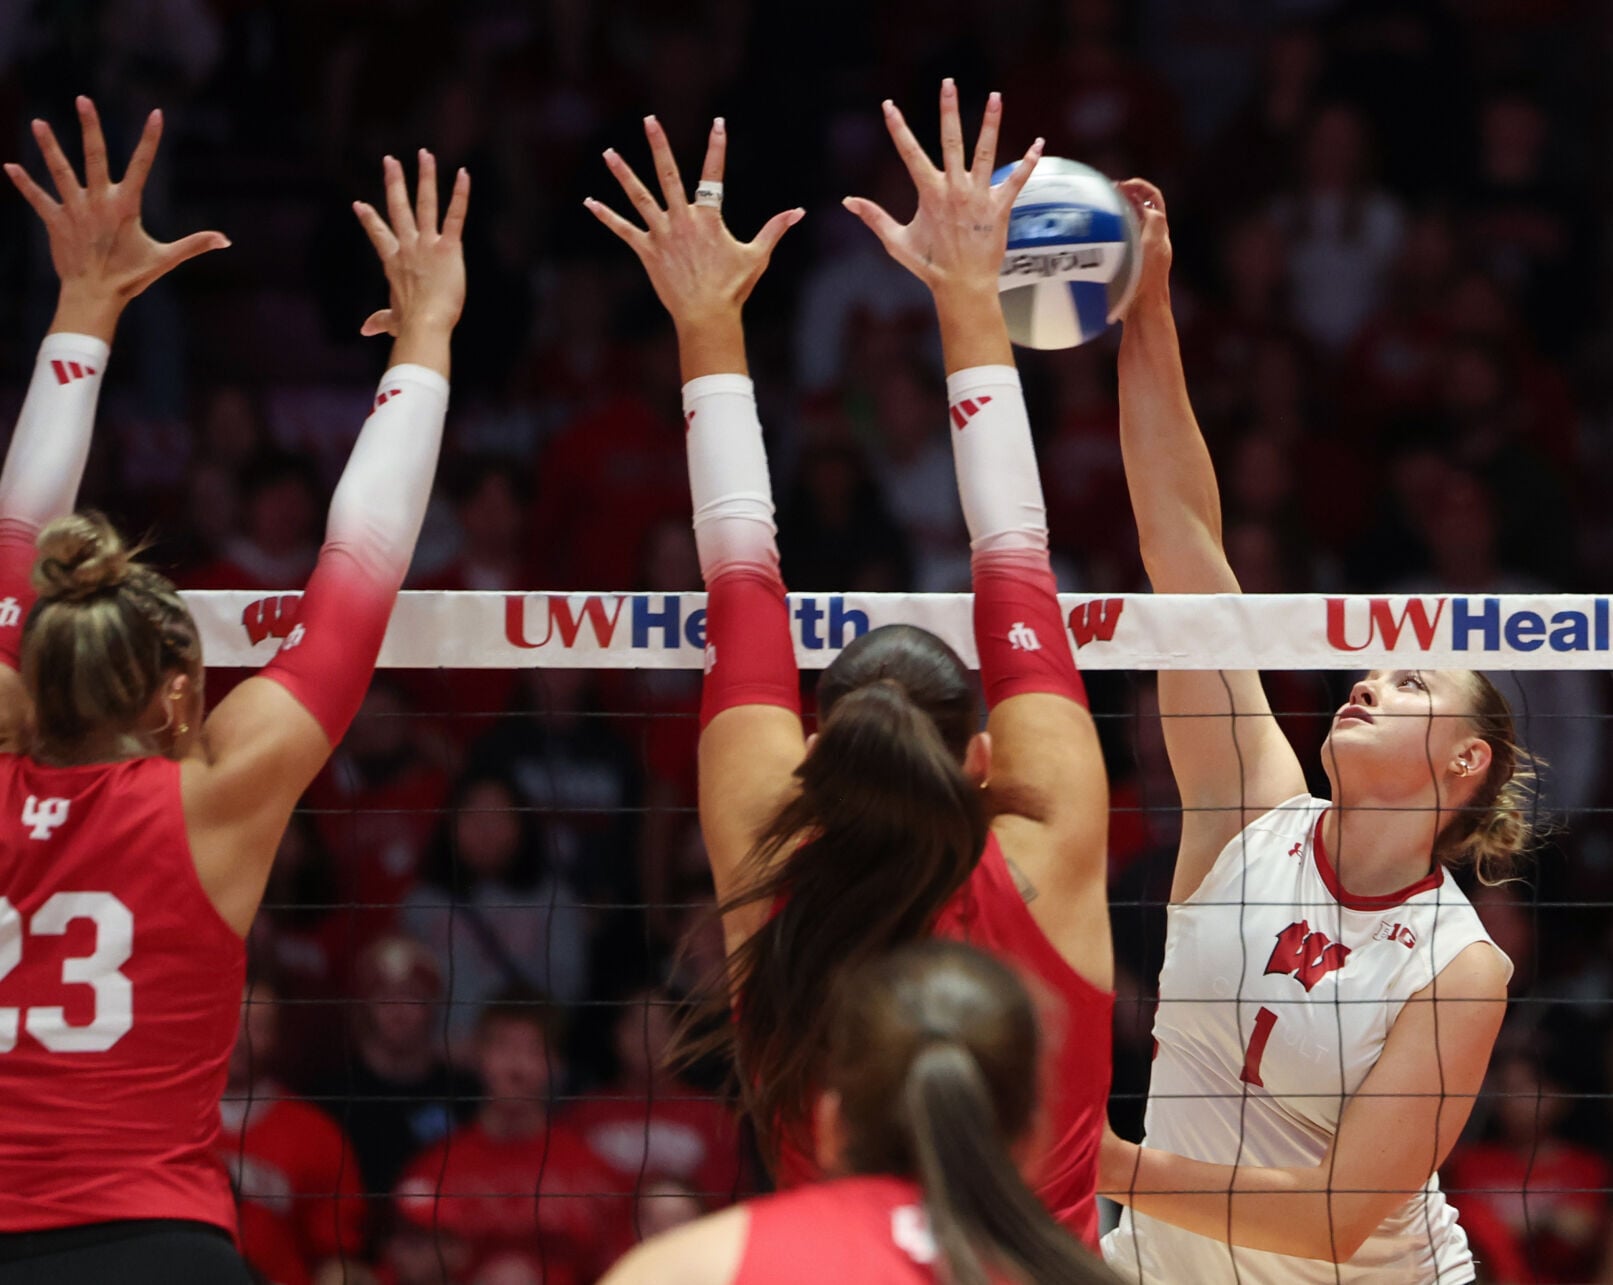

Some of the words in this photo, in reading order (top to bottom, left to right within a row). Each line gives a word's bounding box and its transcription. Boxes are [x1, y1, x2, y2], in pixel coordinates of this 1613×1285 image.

[632, 595, 869, 649] Heth
[1451, 598, 1610, 651] Heal
[0, 891, 134, 1052] 3
[1240, 1006, 1278, 1088] 1
